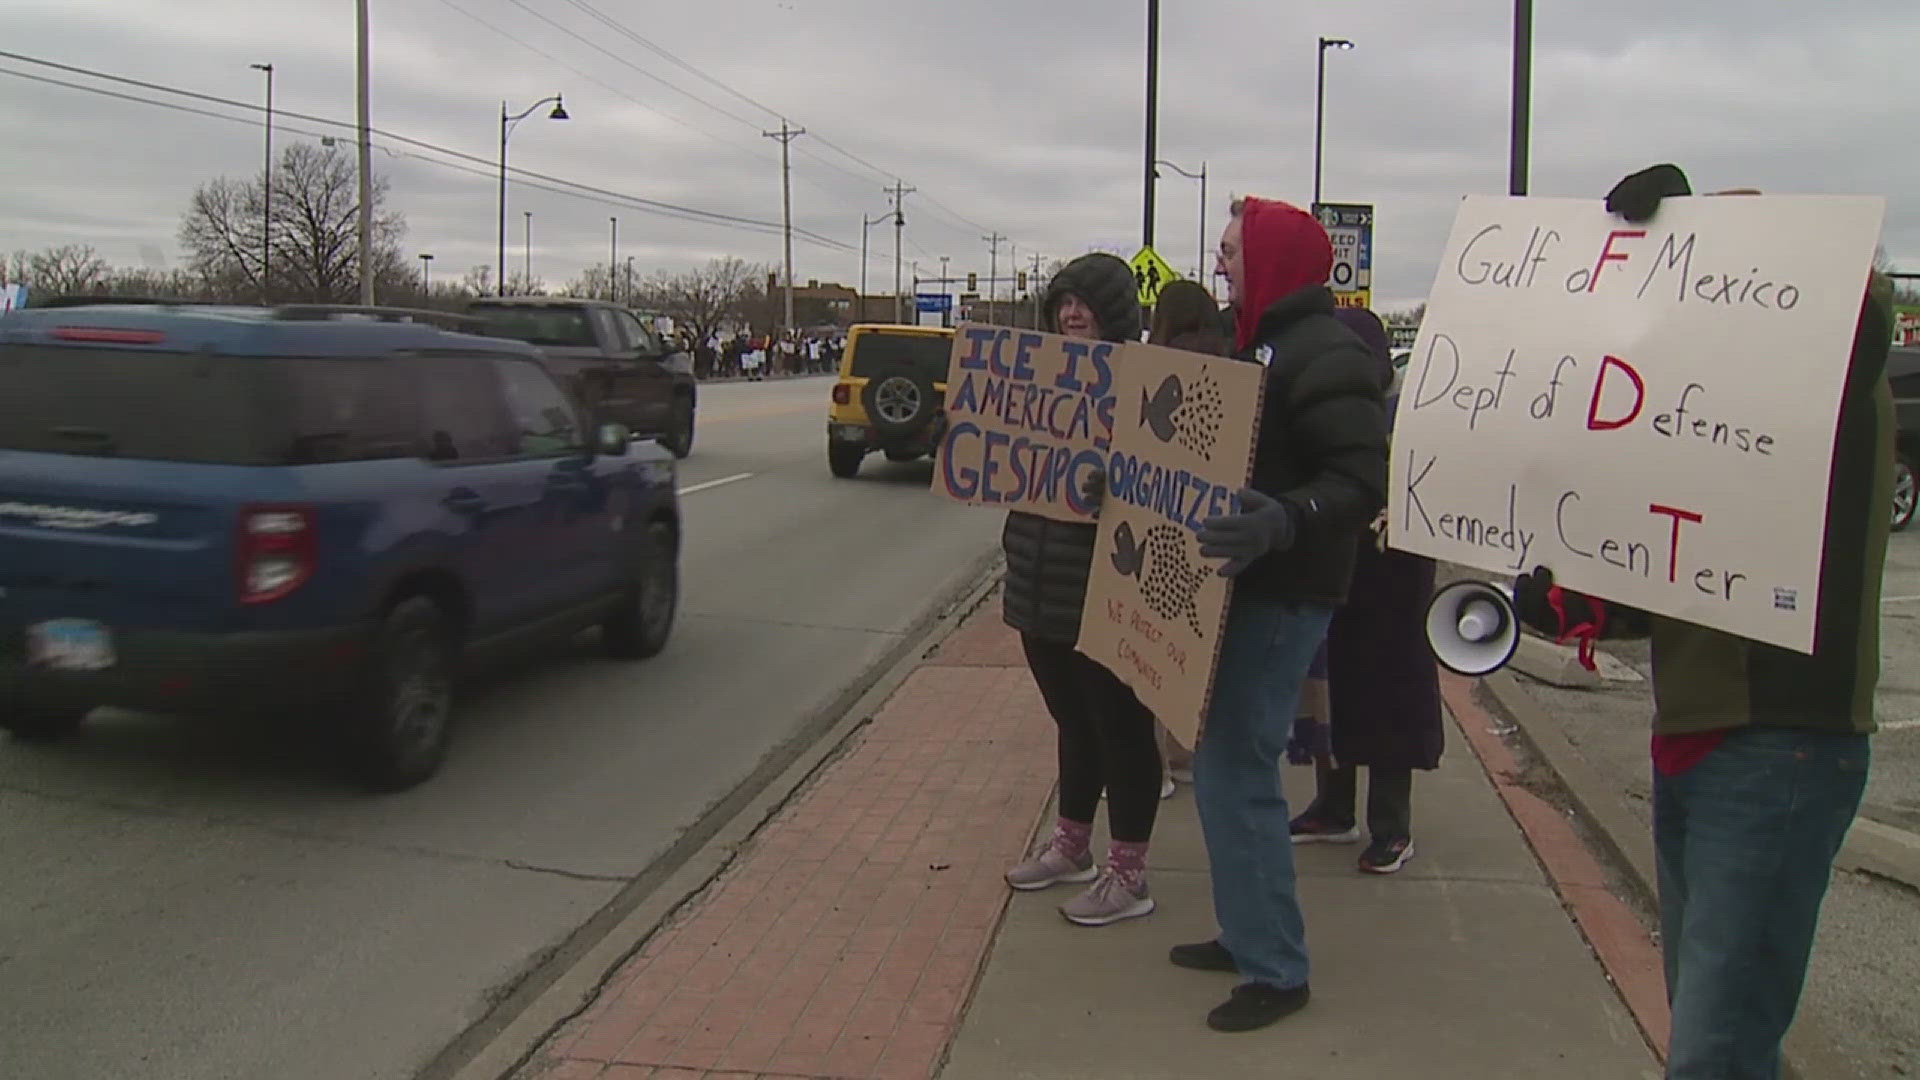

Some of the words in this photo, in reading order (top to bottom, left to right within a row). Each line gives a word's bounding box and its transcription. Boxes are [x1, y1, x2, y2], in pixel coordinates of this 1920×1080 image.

[1331, 234, 1356, 246] EED
[1333, 262, 1352, 285] 0
[1457, 224, 1560, 289] Gulf
[1566, 230, 1647, 293] oF
[1637, 231, 1800, 310] Mexico
[959, 329, 1042, 381] ICE
[1055, 342, 1113, 398] IS
[1414, 334, 1517, 430] Dept
[1530, 356, 1577, 420] of
[1587, 355, 1775, 456] Defense
[951, 372, 1117, 452] AMERICA'S
[943, 421, 1106, 515] GESTAPO
[1404, 449, 1535, 569] Kennedy
[1556, 491, 1748, 601] CenTer
